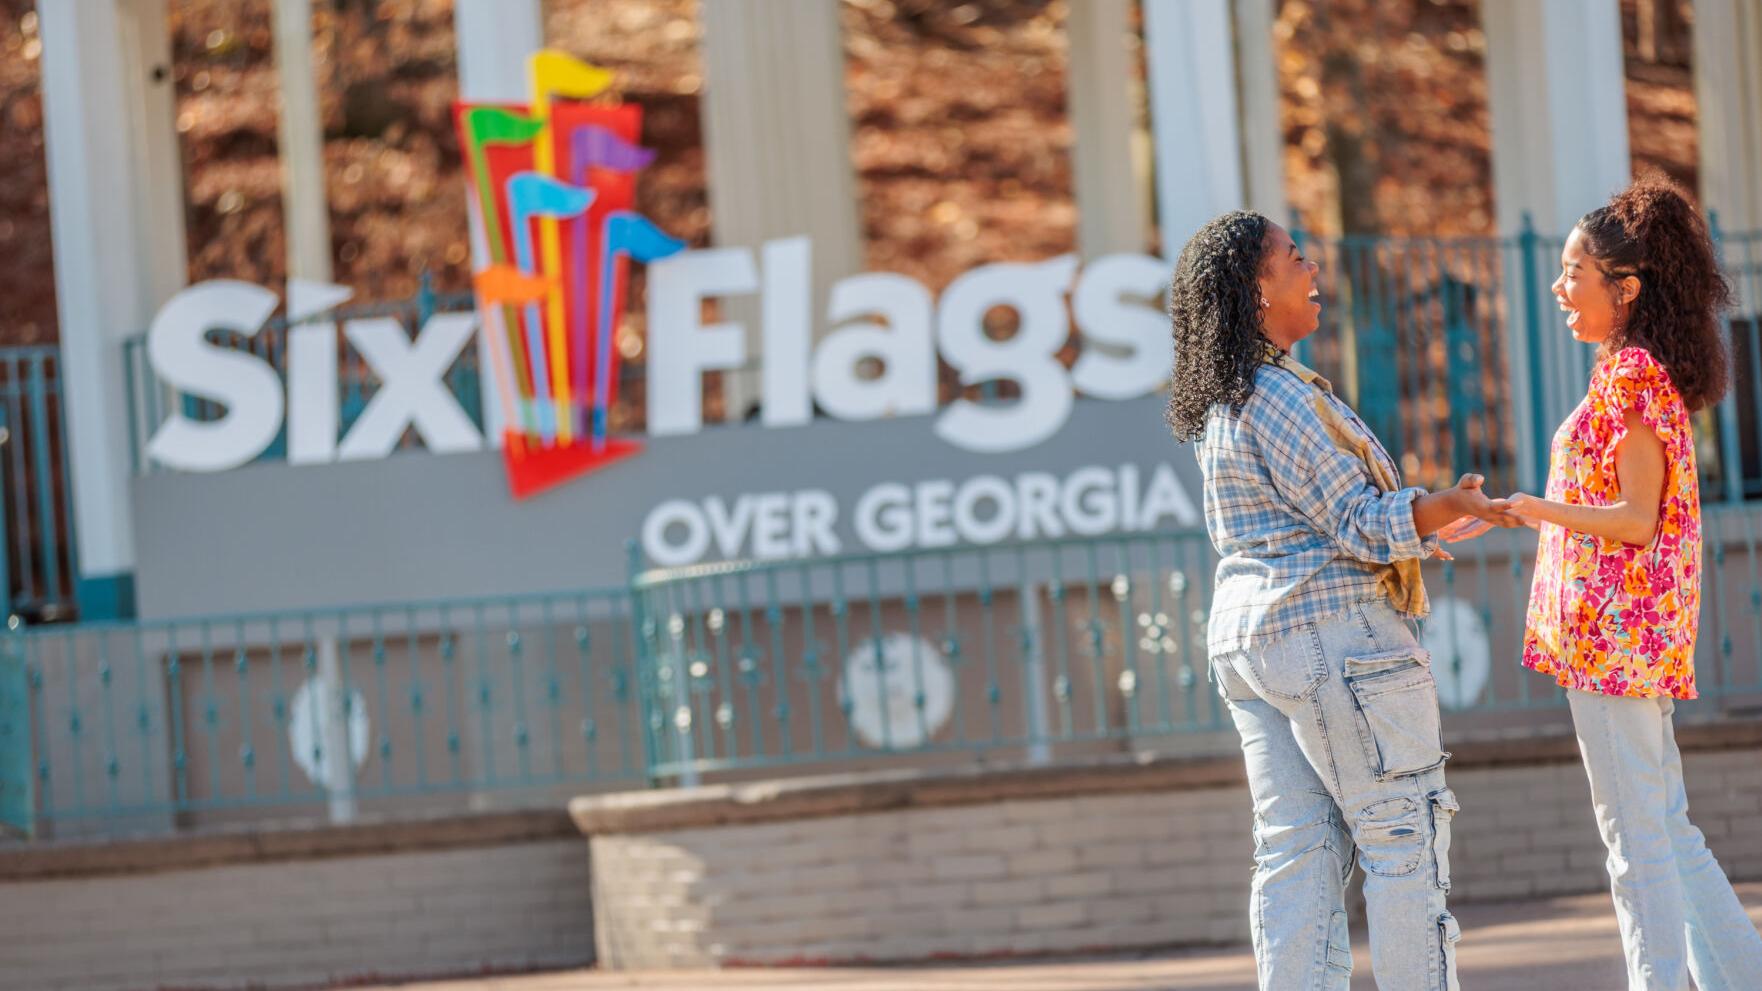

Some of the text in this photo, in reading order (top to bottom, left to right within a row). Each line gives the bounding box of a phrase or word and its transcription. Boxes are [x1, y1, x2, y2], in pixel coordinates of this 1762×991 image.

[147, 236, 1173, 472] Six Flags
[642, 462, 1198, 565] OVER GEORGIA
